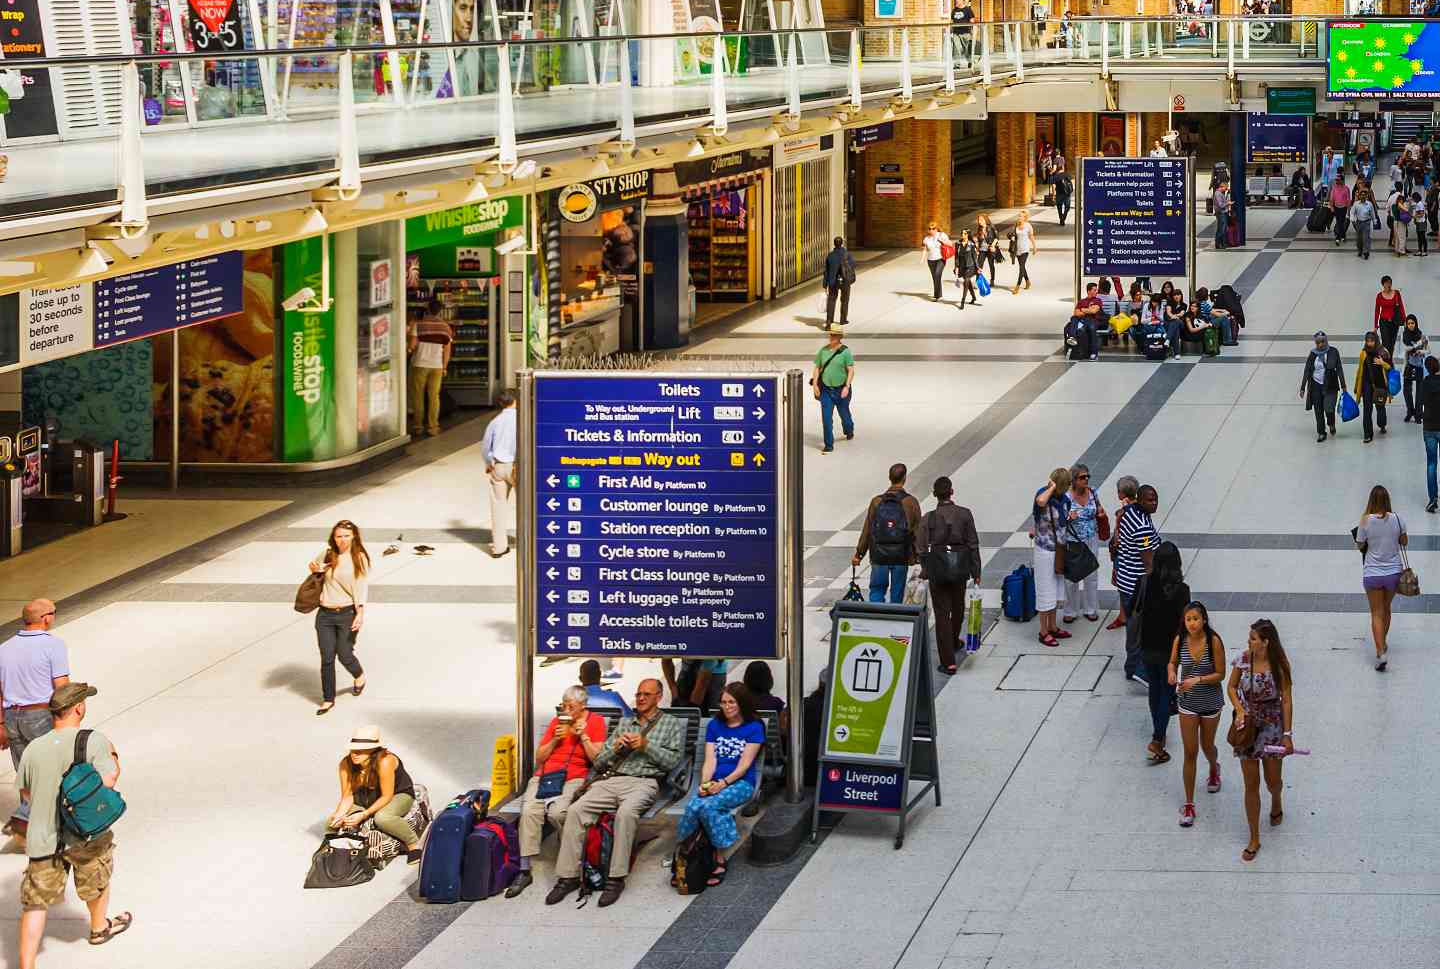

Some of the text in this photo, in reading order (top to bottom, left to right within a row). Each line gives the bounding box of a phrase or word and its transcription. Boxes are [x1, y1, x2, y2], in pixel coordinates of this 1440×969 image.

[200, 7, 226, 19] NOW
[3, 42, 42, 54] ationery
[594, 177, 616, 196] STY
[618, 171, 649, 192] SHOP
[30, 292, 80, 310] close up to
[30, 304, 83, 324] 30 seconds
[30, 324, 60, 338] before
[304, 272, 326, 404] Wistlestop
[30, 332, 74, 352] departure
[659, 384, 700, 397] Toilets
[628, 404, 675, 414] Underground
[679, 406, 701, 420] Lift
[584, 414, 598, 422] and
[565, 429, 701, 443] Tickets & Information
[644, 452, 672, 468] Way
[676, 454, 700, 466] out
[599, 476, 706, 490] First Aid By Platform 10
[600, 499, 766, 514] Customer lounge By Platform 10
[600, 522, 648, 535] Station
[650, 522, 710, 537] reception
[715, 528, 725, 536] By
[726, 528, 756, 536] Platform
[600, 546, 634, 560] Cycle
[636, 546, 670, 558] store
[673, 550, 684, 559] By
[684, 550, 715, 558] Platform
[600, 568, 628, 582] First
[630, 568, 664, 582] Class
[666, 568, 710, 584] lounge
[713, 574, 723, 582] By
[724, 574, 754, 582] Platform
[600, 591, 626, 604] Left
[628, 592, 678, 608] luggage
[682, 588, 692, 596] By
[693, 588, 724, 596] Platform
[682, 596, 731, 606] Lost property
[600, 614, 666, 628] Accessible
[669, 614, 708, 628] toilets
[712, 612, 722, 620] By
[723, 612, 754, 620] Platform
[712, 620, 744, 630] Babycare
[600, 638, 631, 650] Taxis
[635, 642, 645, 652] By
[646, 642, 677, 650] Platform
[846, 770, 897, 785] Liverpool
[844, 788, 878, 801] Street
